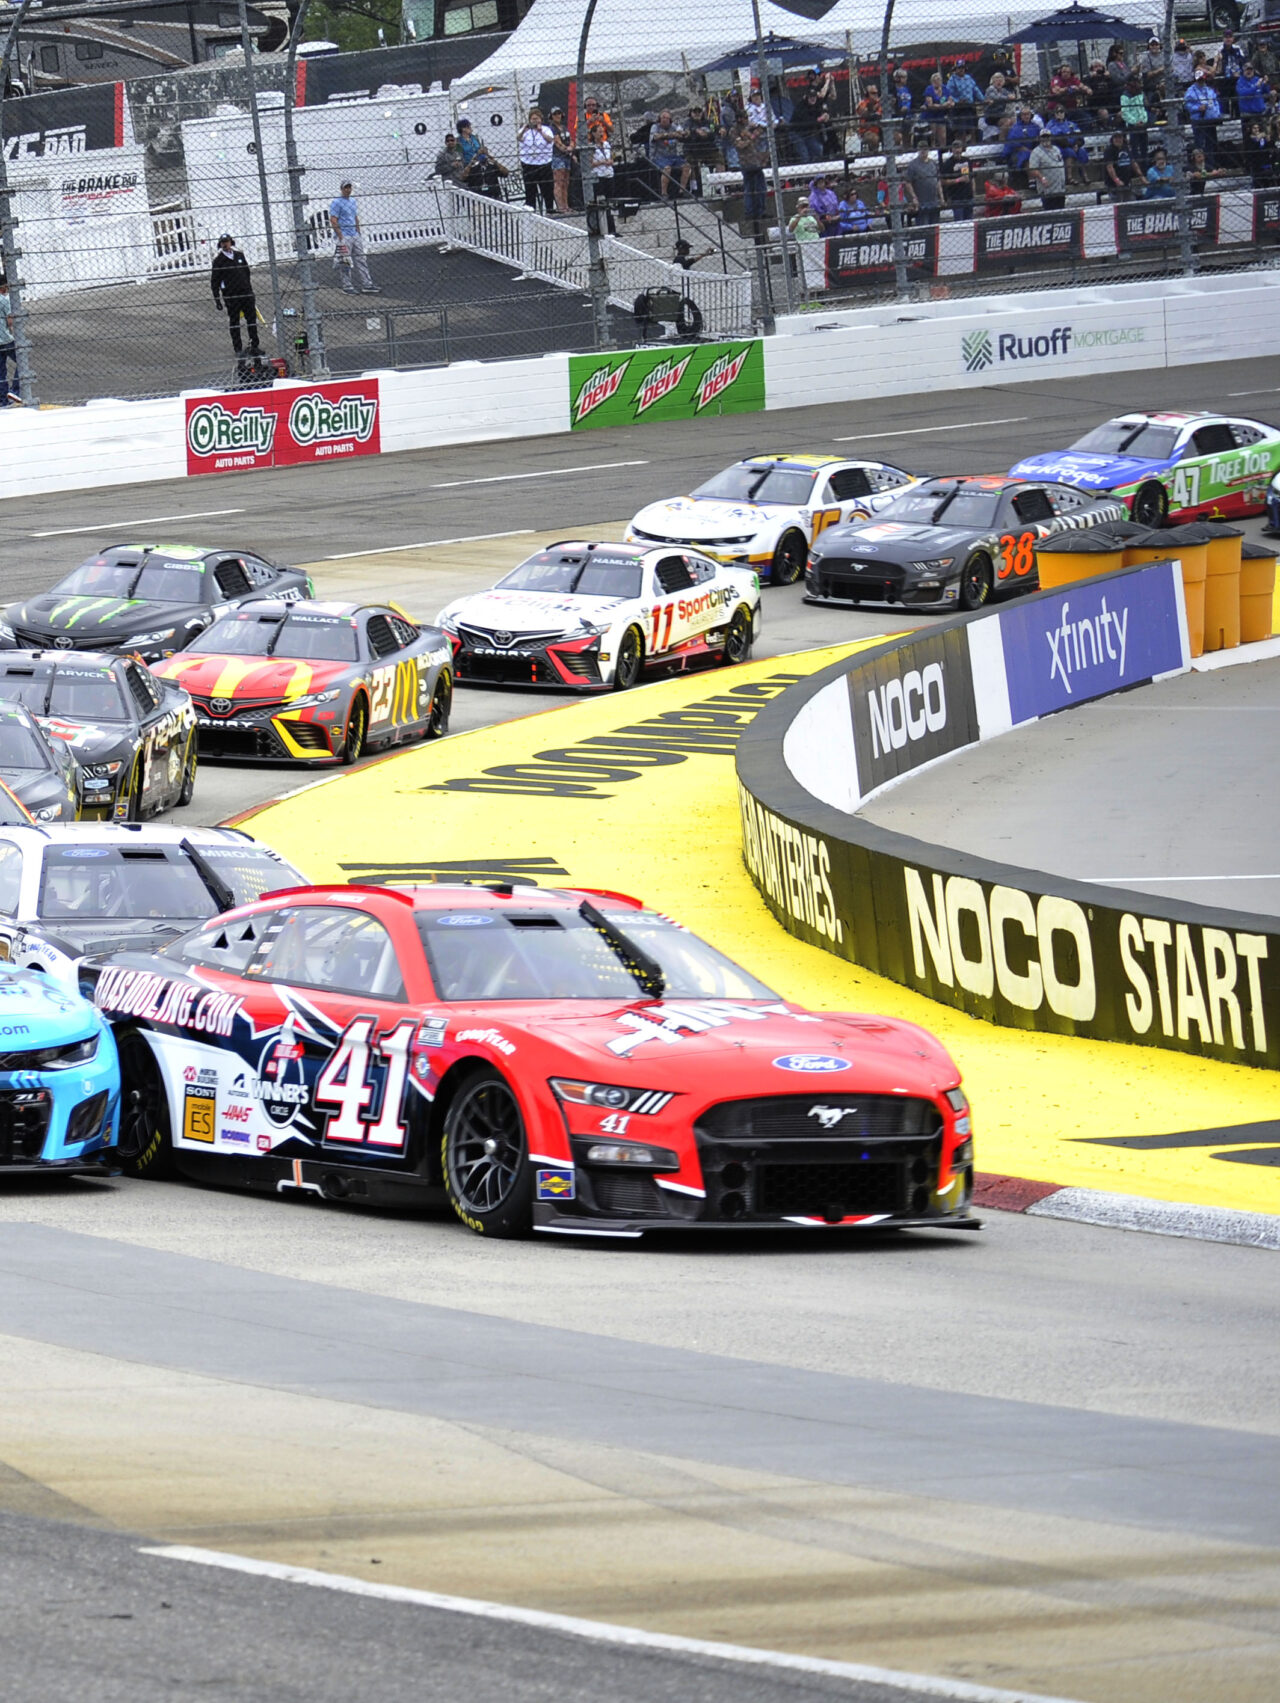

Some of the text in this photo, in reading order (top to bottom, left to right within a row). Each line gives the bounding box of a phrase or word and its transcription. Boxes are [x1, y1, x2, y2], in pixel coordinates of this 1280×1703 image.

[78, 174, 121, 194] BRAKE
[985, 223, 1072, 251] THE BRAKE PAD
[1144, 213, 1190, 234] BRA
[837, 239, 927, 268] THE BRA PAD
[999, 325, 1145, 362] Ruoff MORTGAGE
[191, 411, 274, 450] O'Reilly
[292, 399, 372, 439] O'Reilly
[214, 455, 256, 469] AUTO PARTS
[314, 442, 355, 457] AUTO PARTS
[1205, 457, 1241, 484] TREE
[1239, 450, 1271, 474] TOP
[1172, 466, 1202, 508] 47
[591, 557, 639, 567] HAMLIN
[997, 531, 1036, 580] 38
[291, 615, 340, 625] WALLACE
[648, 602, 675, 656] 11
[473, 647, 532, 658] CAMRY
[1044, 595, 1129, 694] xfinity
[370, 664, 397, 725] 23
[198, 718, 254, 728] AMRY
[866, 662, 947, 760] NOCO
[177, 848, 266, 861] AMIROLA
[602, 914, 665, 926] REECE
[903, 865, 1096, 1022] NOCO
[1119, 913, 1268, 1053] START
[455, 1028, 517, 1056] GOODYEAR
[186, 1086, 216, 1098] SONY
[313, 1015, 419, 1149] 41
[191, 1103, 211, 1111] mobile
[191, 1111, 212, 1135] ES
[600, 1113, 631, 1135] 41
